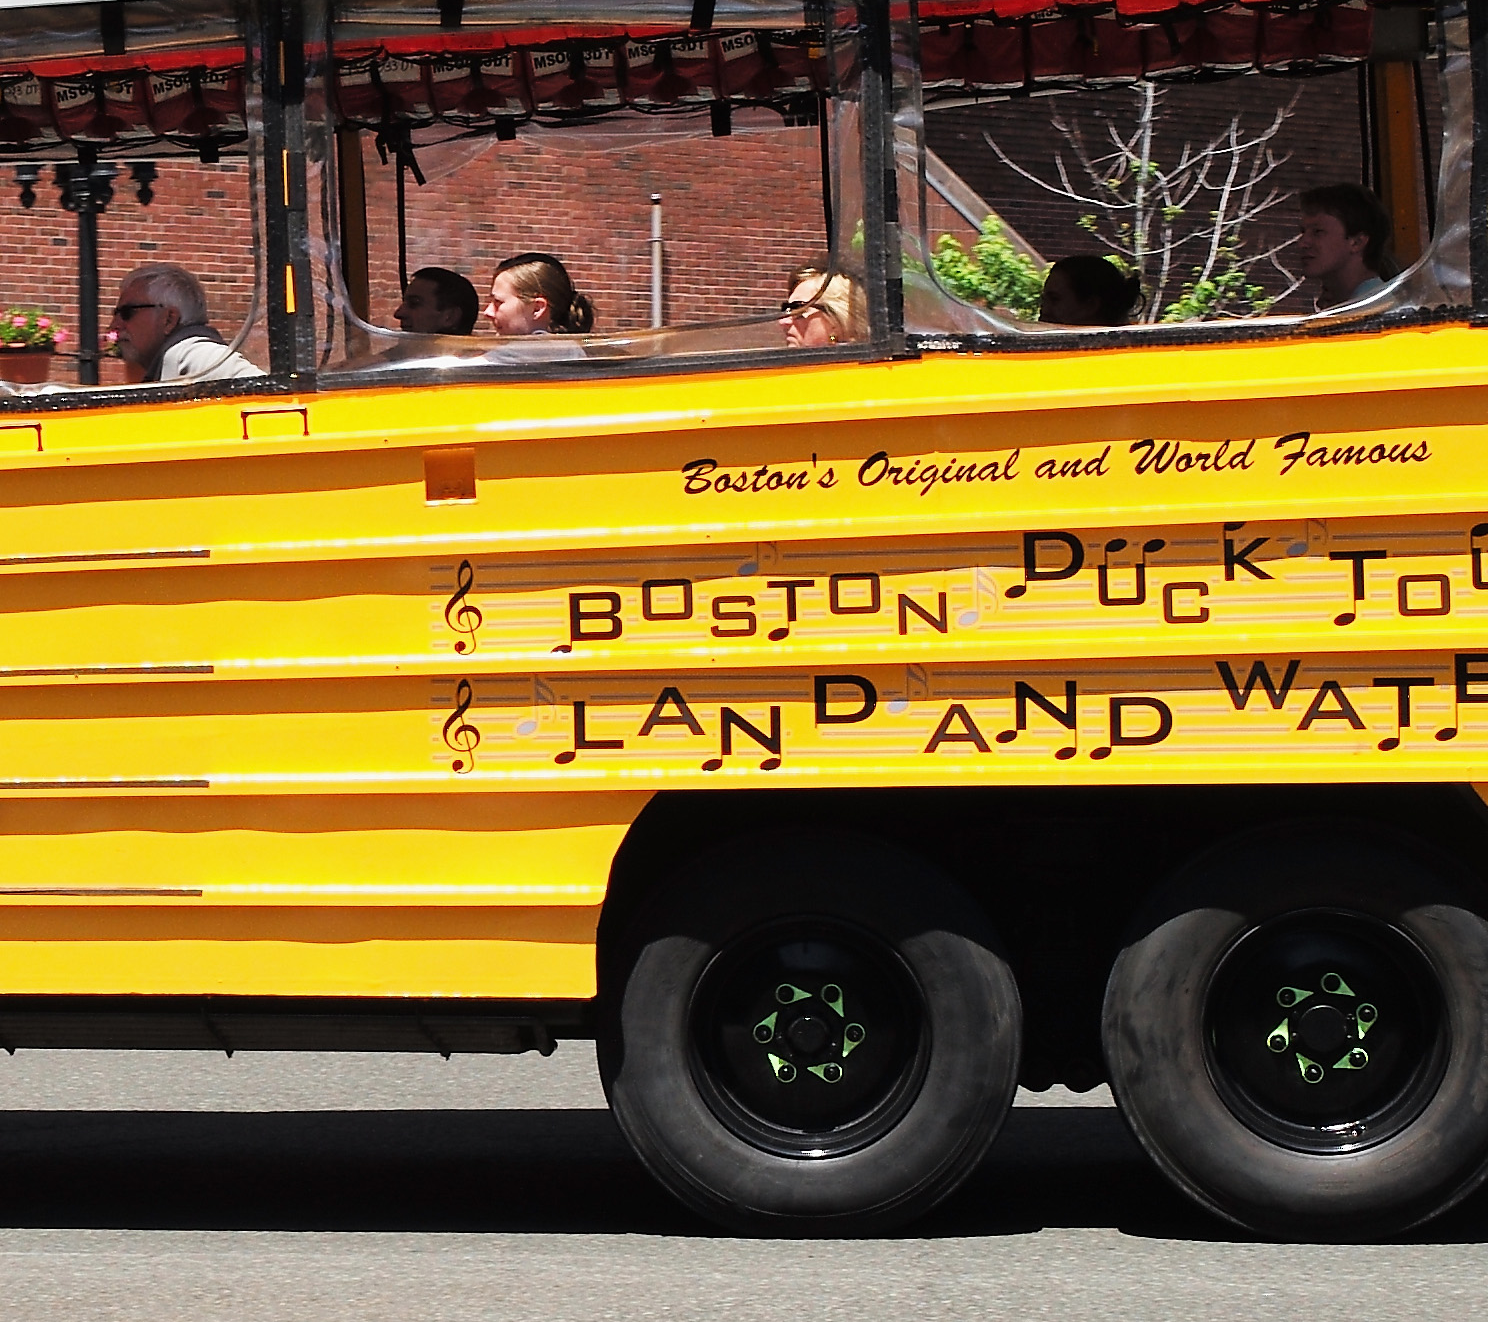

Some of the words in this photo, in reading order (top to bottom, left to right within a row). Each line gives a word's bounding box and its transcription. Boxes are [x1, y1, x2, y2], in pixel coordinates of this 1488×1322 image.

[681, 452, 839, 495] Boston's
[857, 448, 1020, 497] Original
[1035, 447, 1110, 481] and
[1129, 438, 1256, 476] World
[1274, 431, 1431, 477] Famous
[560, 572, 948, 647] BOSTON
[1014, 525, 1276, 624] DUCK
[559, 675, 878, 768] LAND
[922, 680, 1173, 761] AND
